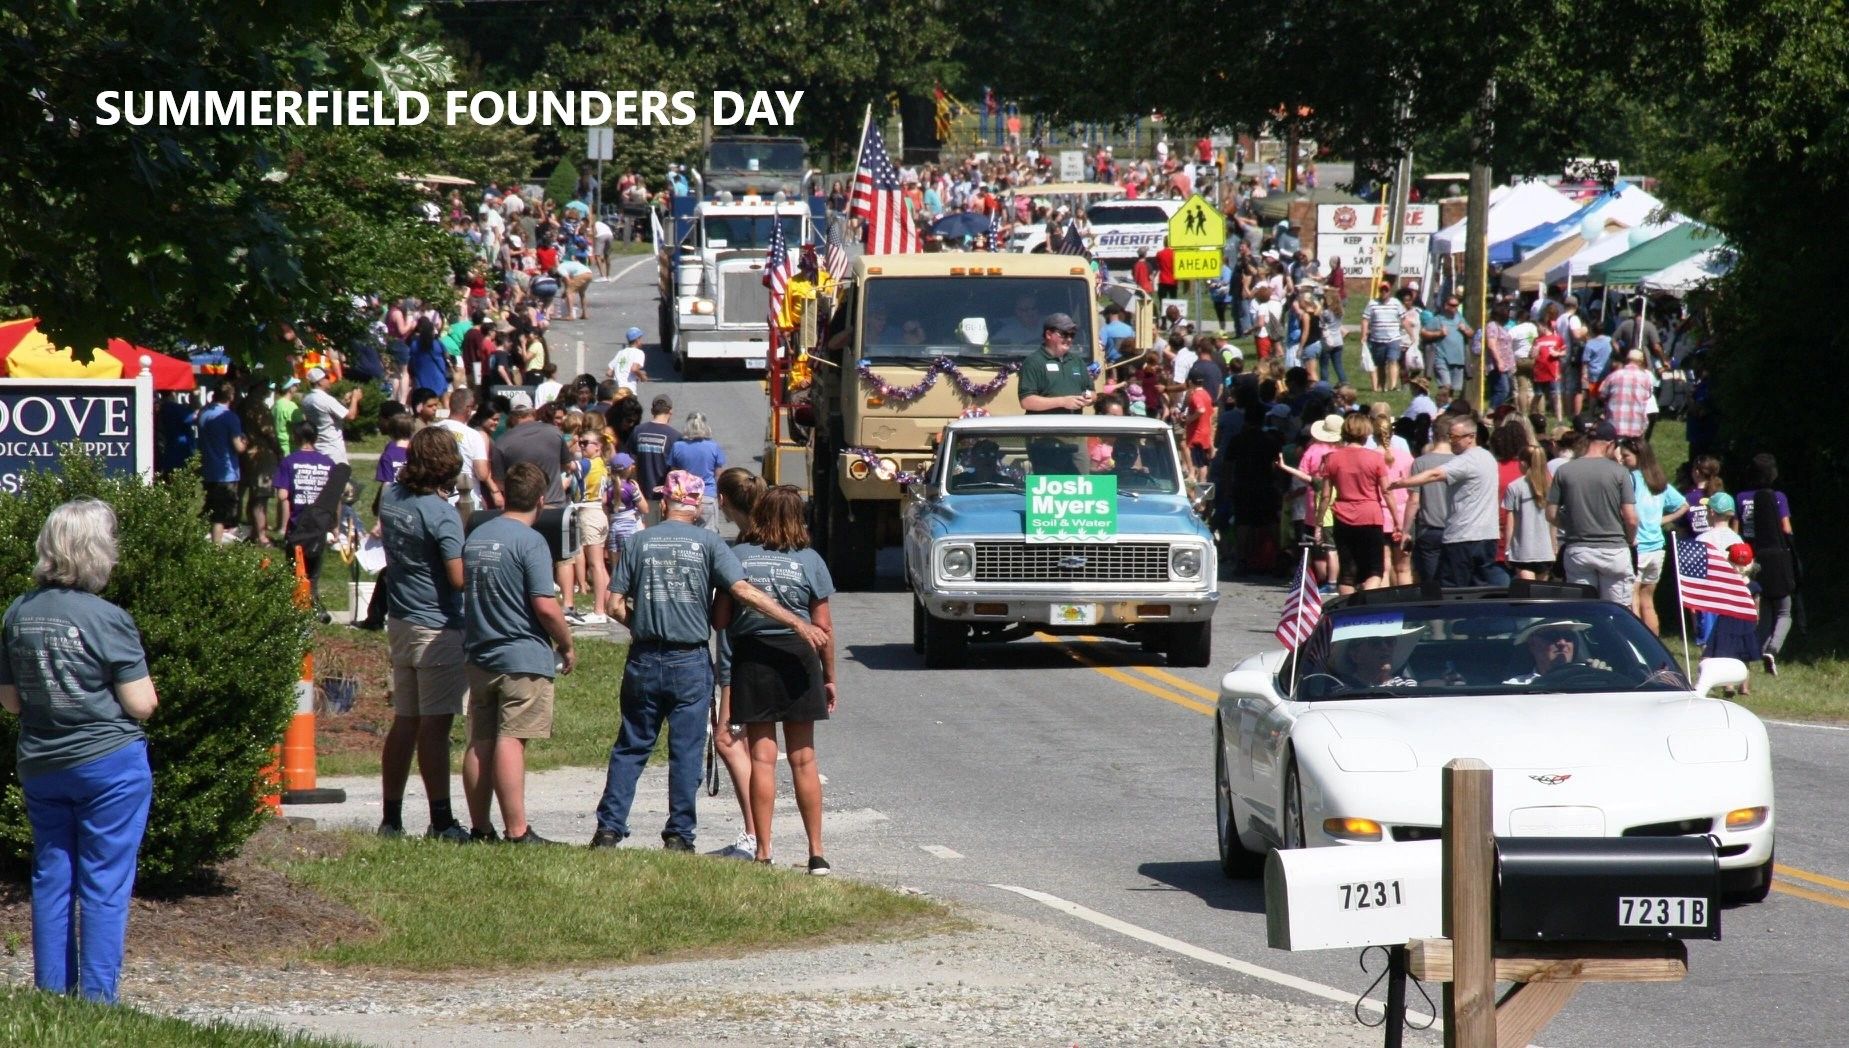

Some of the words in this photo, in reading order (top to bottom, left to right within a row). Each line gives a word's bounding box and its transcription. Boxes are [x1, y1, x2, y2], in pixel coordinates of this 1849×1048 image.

[1372, 206, 1423, 225] FRE
[1100, 234, 1163, 246] SHERIFF
[1343, 236, 1362, 244] KEEP
[1178, 258, 1218, 270] AHEAD
[1353, 257, 1373, 265] SAFE
[1343, 266, 1363, 275] OUND
[0, 396, 130, 436] OVE
[1031, 476, 1093, 495] Josh
[1032, 495, 1110, 518] Myers
[1032, 518, 1057, 527] Soil
[1059, 518, 1070, 527] &
[1072, 518, 1112, 527] Water
[1339, 880, 1402, 909] 7231
[1621, 899, 1705, 925] 7231B
